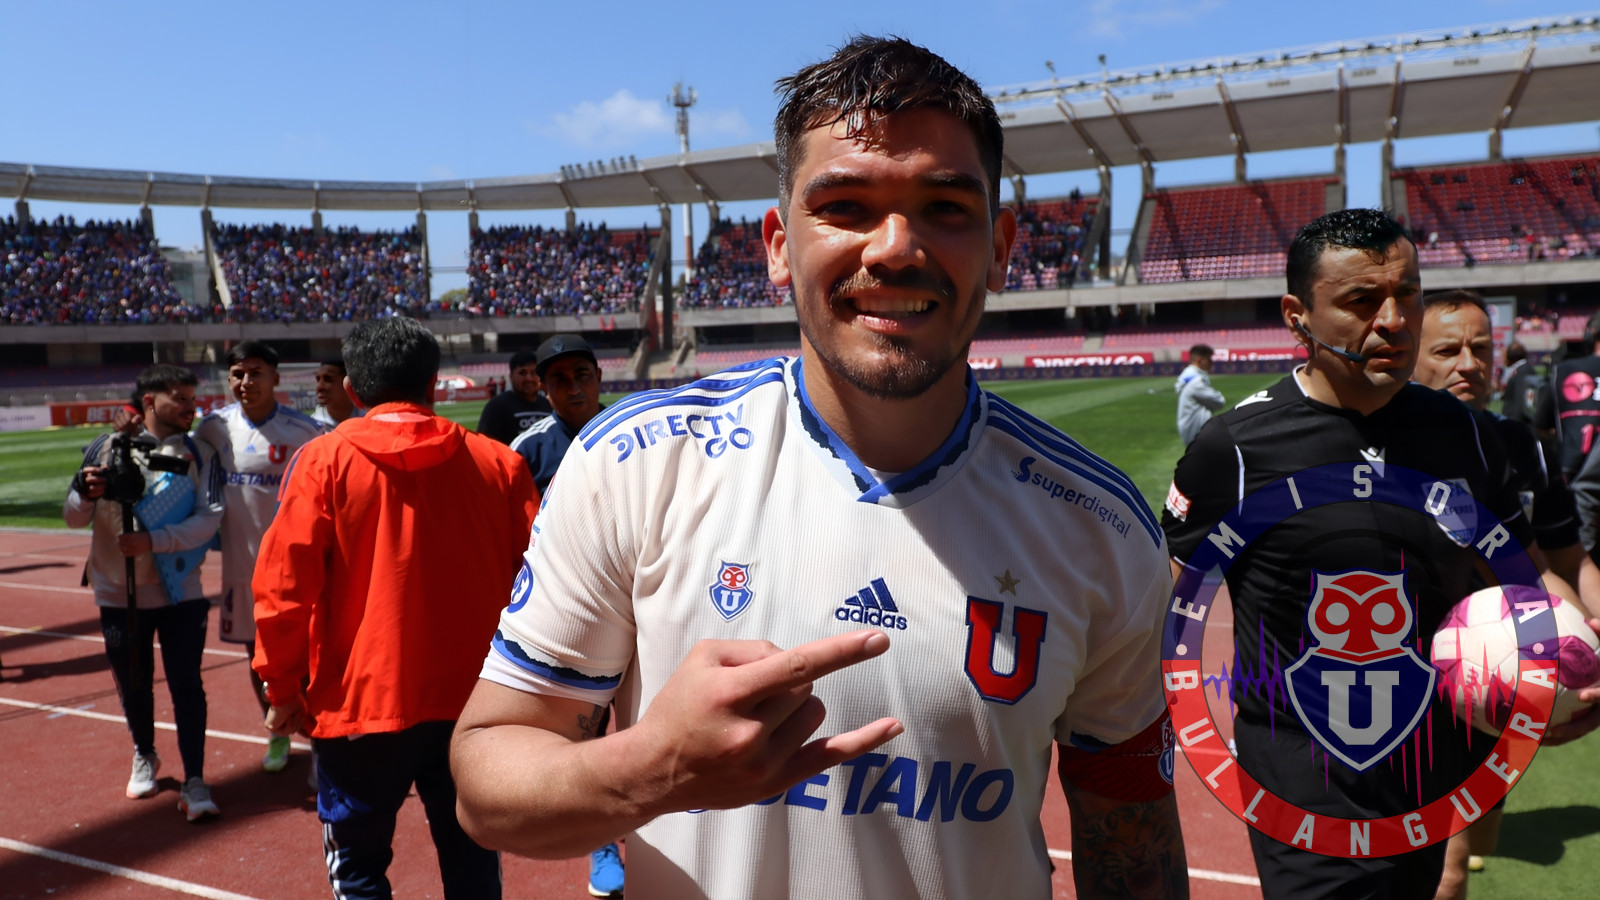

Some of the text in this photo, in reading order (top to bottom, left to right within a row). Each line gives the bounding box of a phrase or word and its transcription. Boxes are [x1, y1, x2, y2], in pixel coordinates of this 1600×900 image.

[609, 403, 743, 463] DIRECTV
[705, 427, 754, 459] GO
[229, 471, 282, 486] BETAN
[1032, 472, 1131, 539] superdigital
[720, 590, 742, 611] U
[835, 605, 907, 630] adidas
[964, 595, 1048, 705] U
[752, 752, 1015, 823] ETANO
